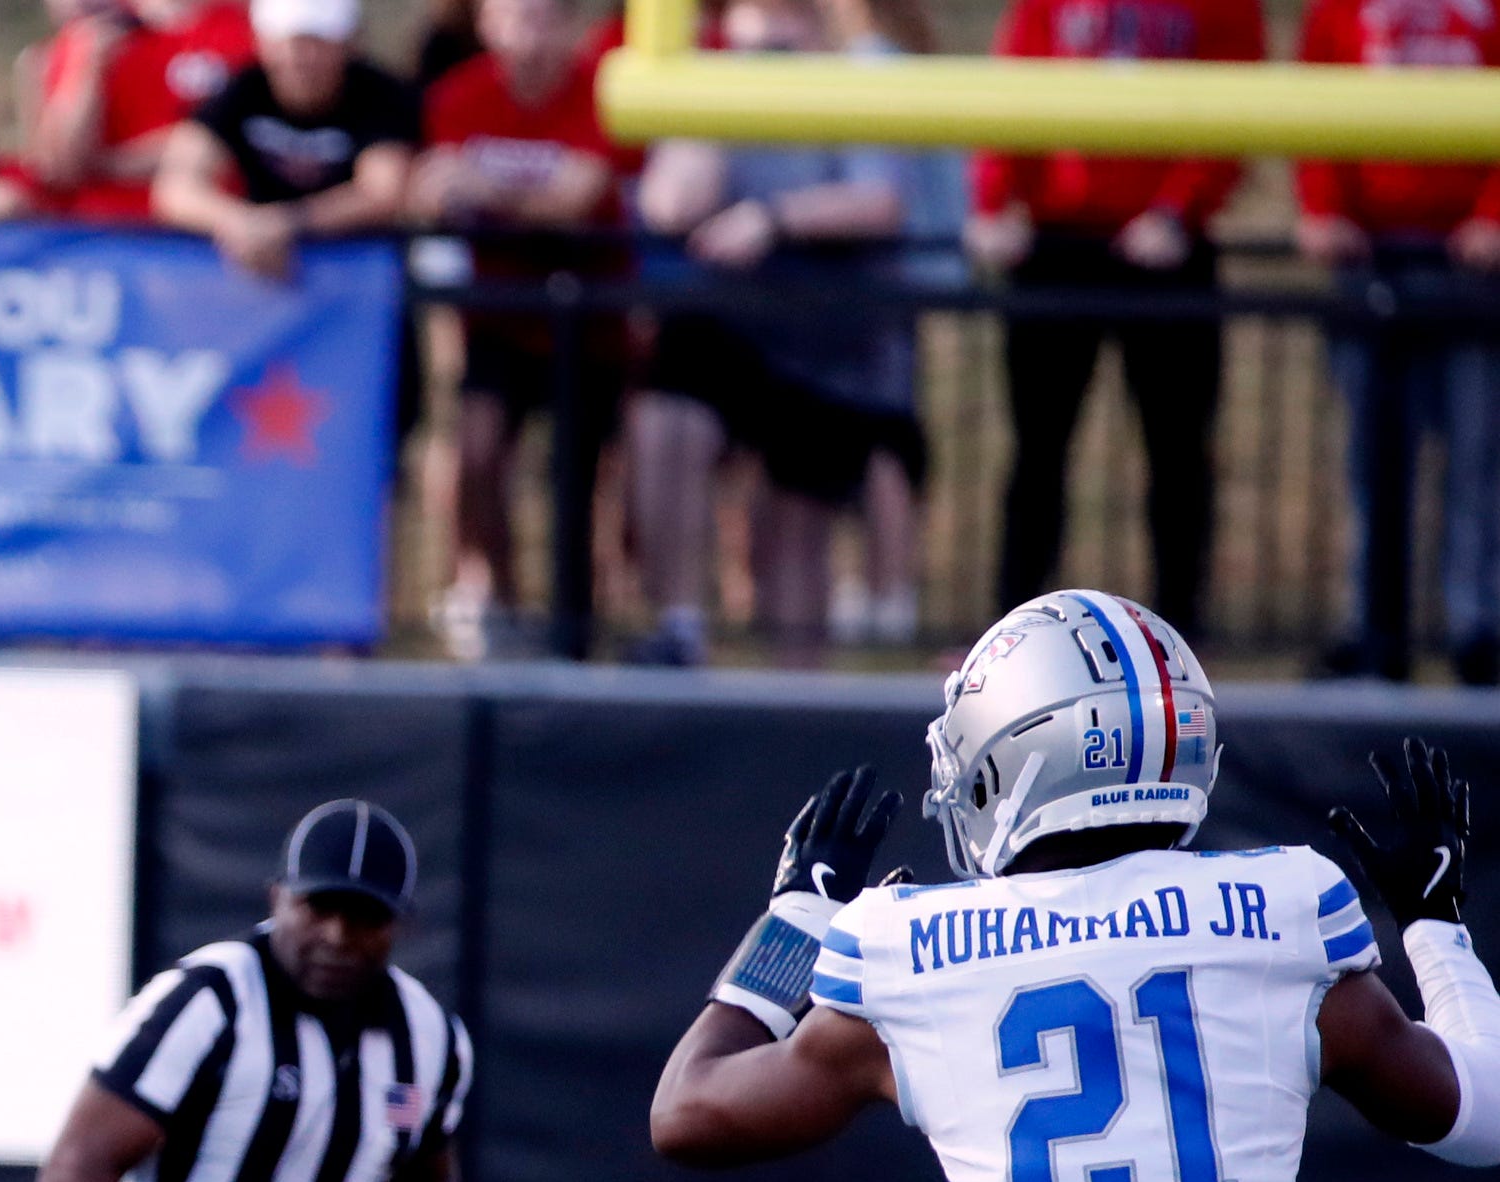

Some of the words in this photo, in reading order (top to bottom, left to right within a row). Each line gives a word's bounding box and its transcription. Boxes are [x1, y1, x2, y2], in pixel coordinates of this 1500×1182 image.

[1082, 726, 1127, 770] 21
[1092, 791, 1129, 806] BLUE
[1134, 788, 1190, 801] RAIDERS
[909, 885, 1191, 975] MUHAMMAD
[1210, 881, 1281, 942] JR.
